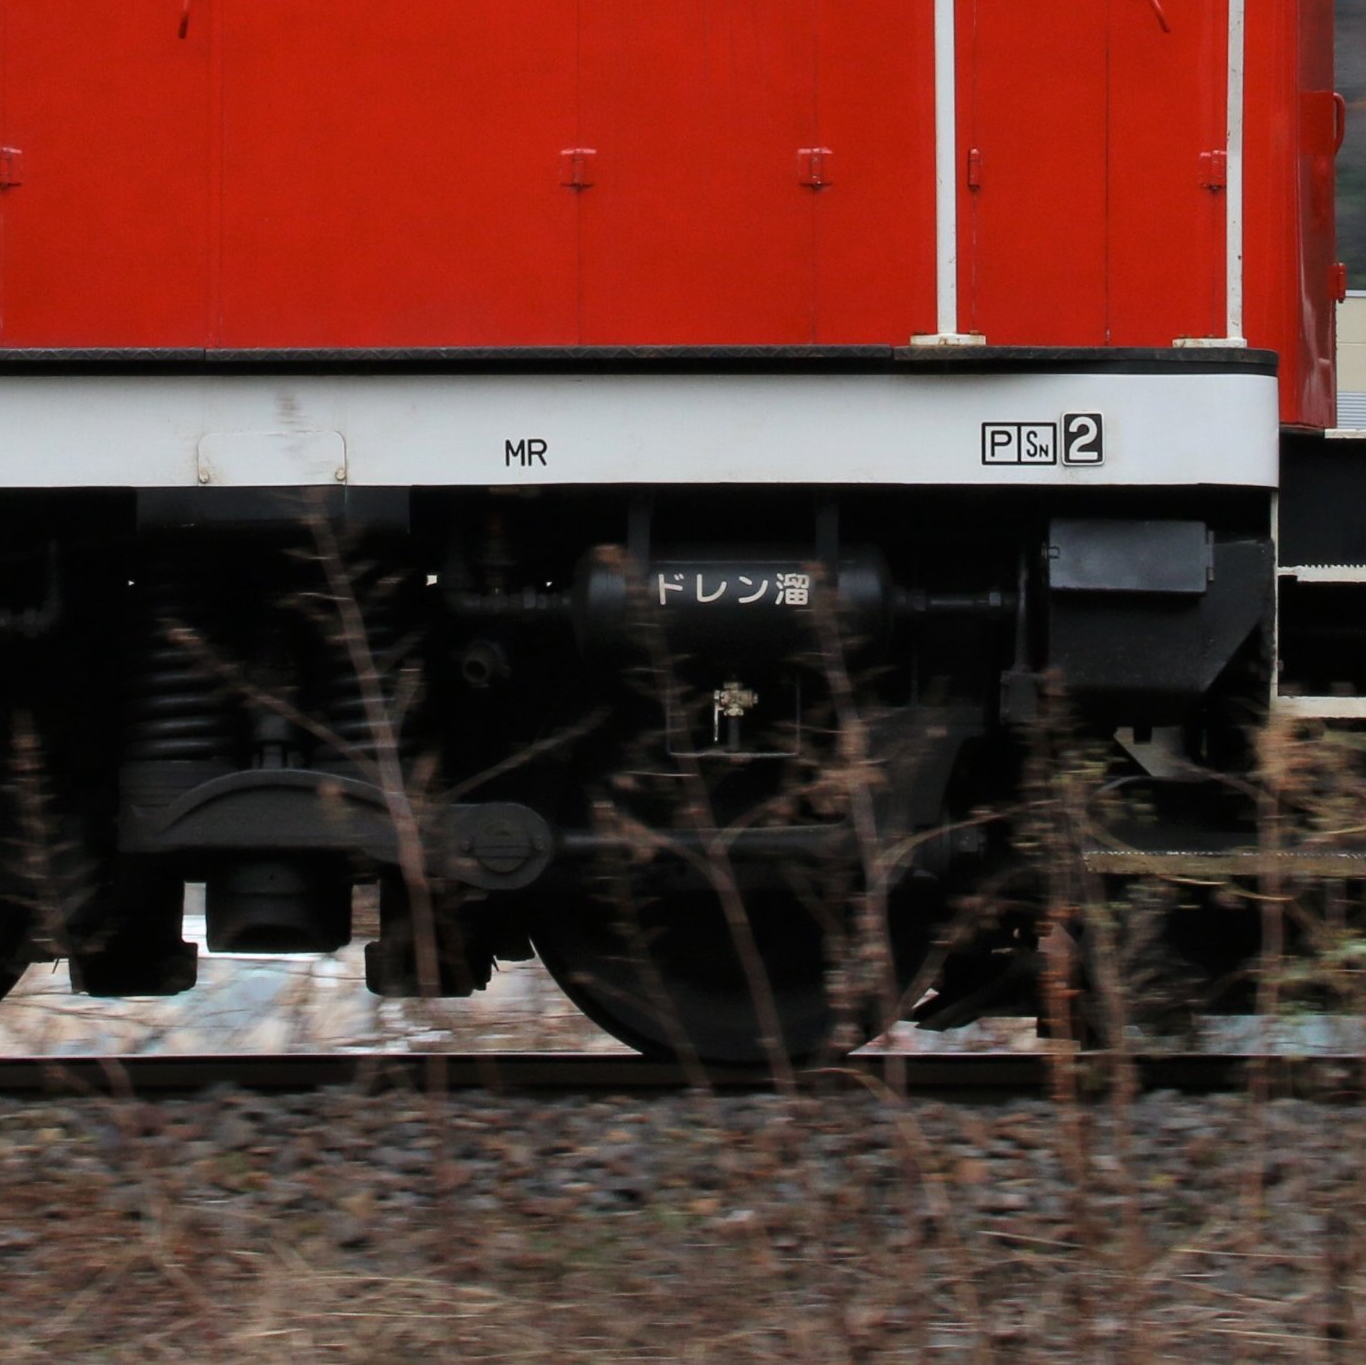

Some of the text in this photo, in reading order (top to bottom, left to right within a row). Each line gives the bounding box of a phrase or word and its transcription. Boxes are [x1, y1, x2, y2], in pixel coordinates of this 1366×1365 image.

[504, 438, 549, 467] MR
[1068, 415, 1099, 461] 2
[658, 572, 811, 606] ドレン溜
